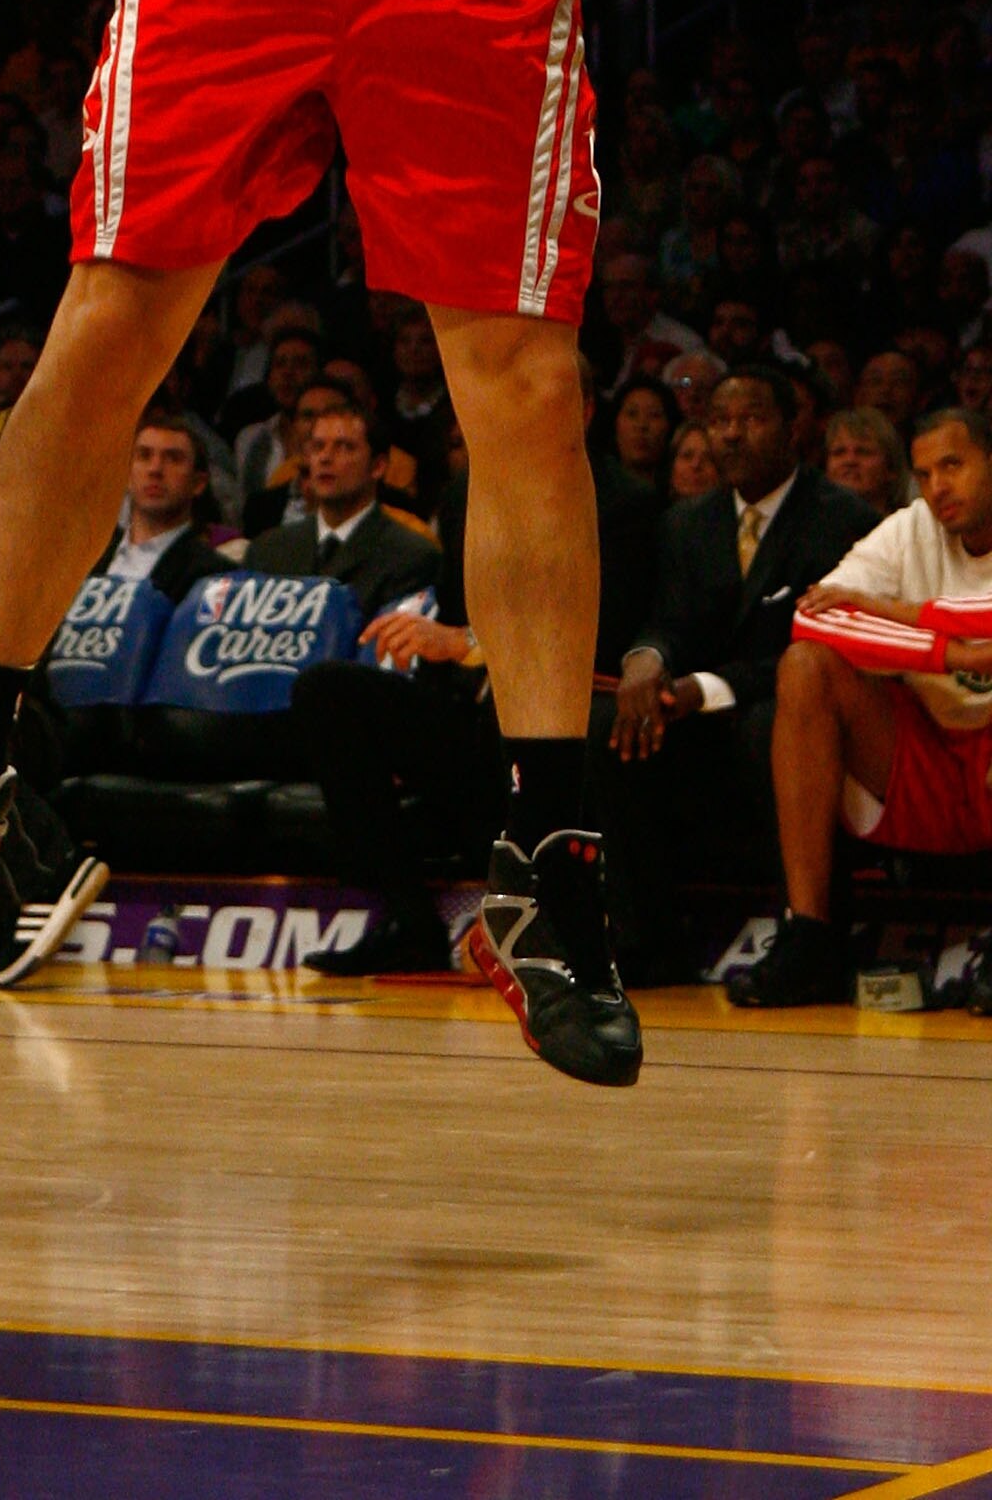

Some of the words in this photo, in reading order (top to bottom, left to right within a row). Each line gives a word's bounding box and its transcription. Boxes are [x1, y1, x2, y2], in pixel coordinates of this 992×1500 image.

[66, 577, 139, 623] BA
[222, 578, 332, 625] NBA
[51, 624, 124, 658] res
[184, 623, 316, 677] Cares
